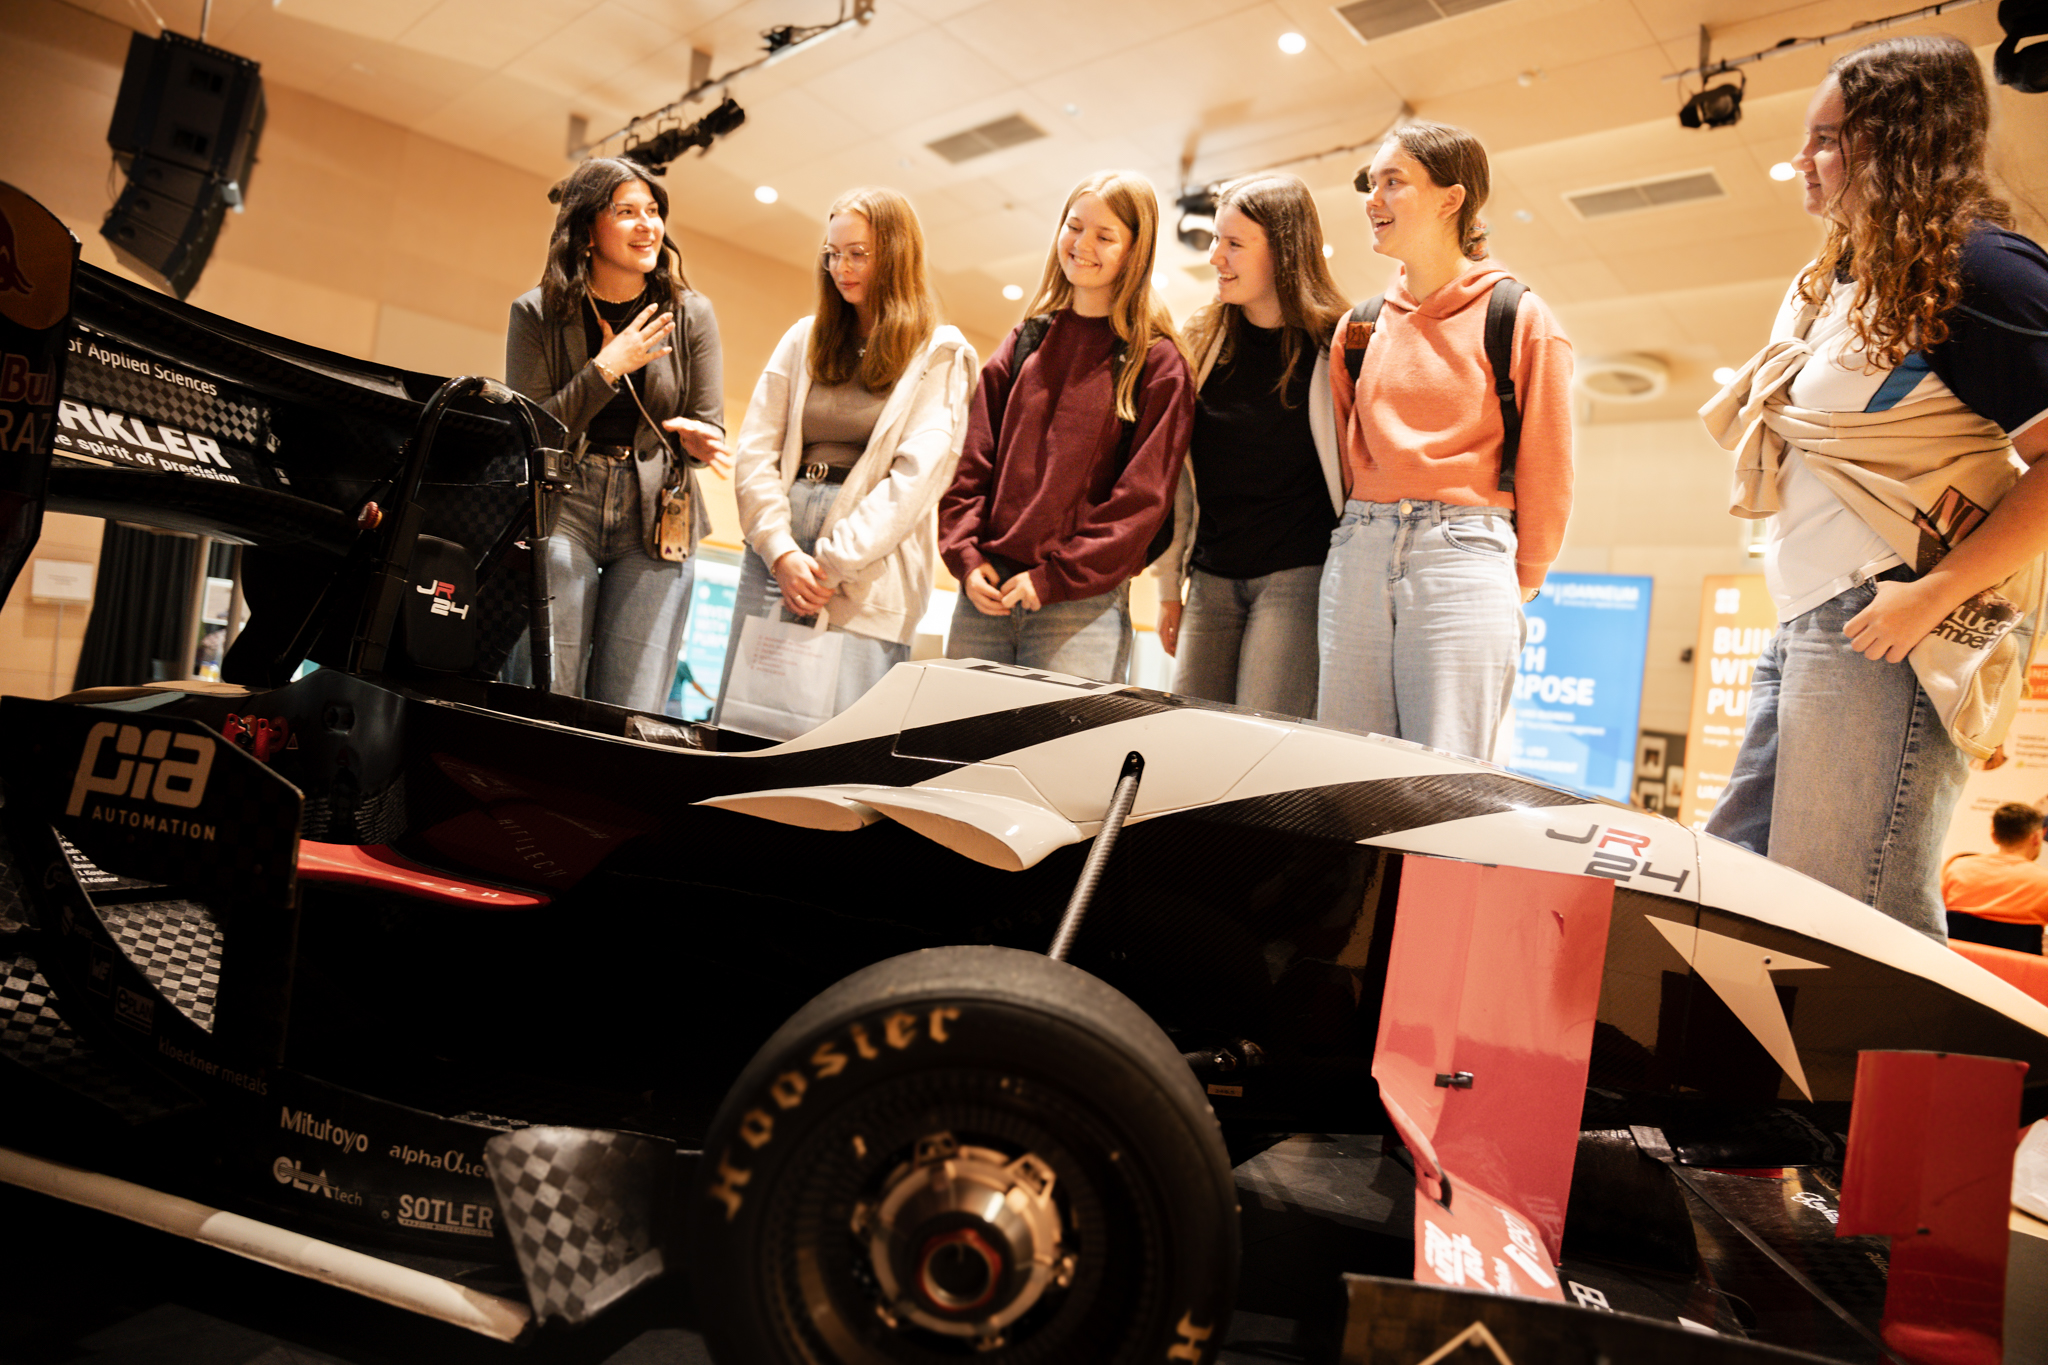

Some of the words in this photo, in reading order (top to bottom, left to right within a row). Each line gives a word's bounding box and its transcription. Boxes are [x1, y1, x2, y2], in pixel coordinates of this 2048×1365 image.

[88, 342, 150, 376] Applied
[154, 363, 218, 397] Sciences
[57, 398, 232, 470] RKLER
[76, 438, 134, 462] spirit
[136, 451, 156, 466] of
[159, 458, 241, 485] precision
[416, 579, 456, 600] JR
[430, 596, 470, 621] 24
[91, 805, 218, 842] AUTOMATION
[1545, 823, 1652, 858] JR
[1584, 851, 1690, 893] 24
[158, 1035, 220, 1078] kloeckner
[221, 1066, 269, 1097] metals
[279, 1105, 369, 1154] Mitutoyo
[397, 1193, 494, 1230] SOTLER
